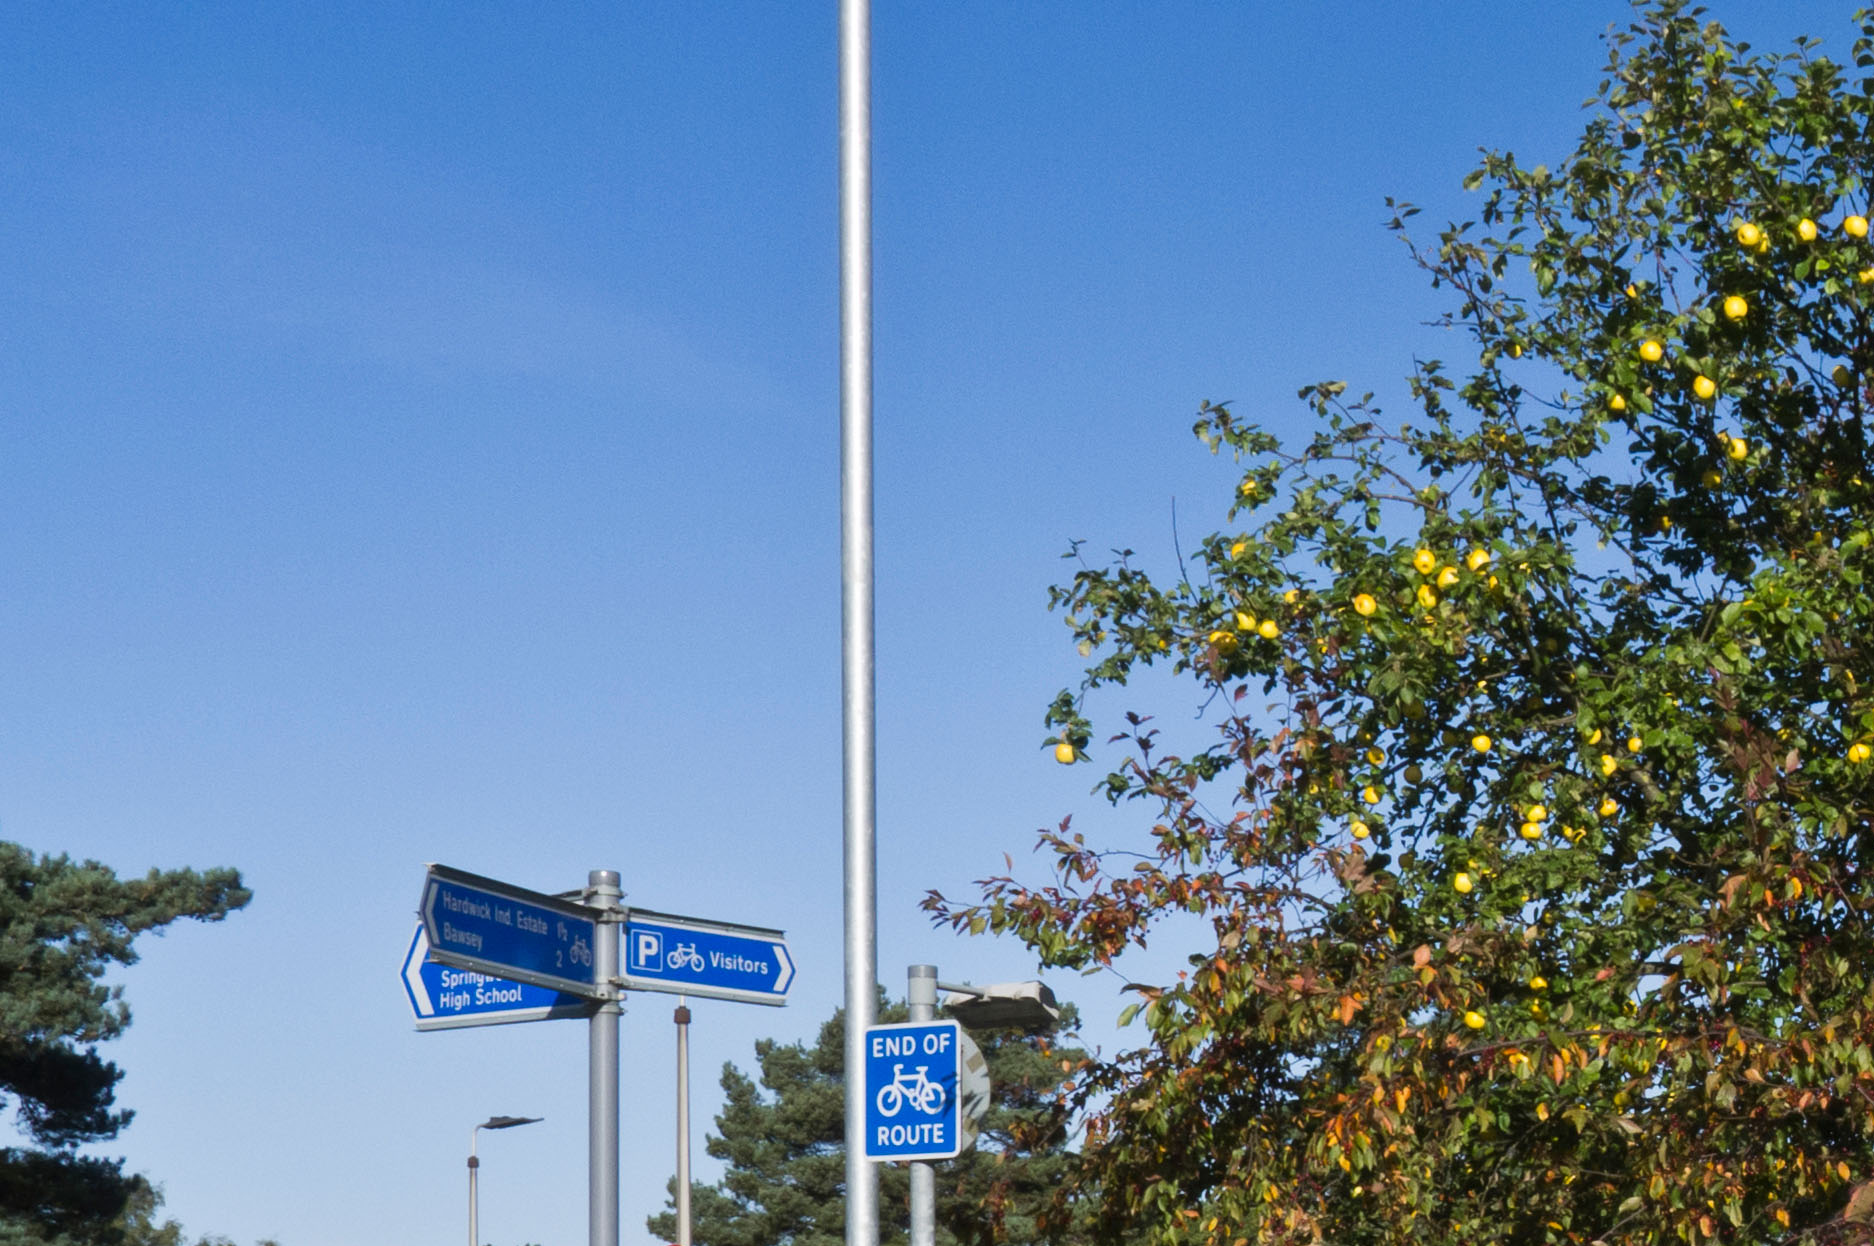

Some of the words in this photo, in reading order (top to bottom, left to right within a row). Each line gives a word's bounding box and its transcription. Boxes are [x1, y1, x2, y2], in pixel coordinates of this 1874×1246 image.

[442, 890, 492, 920] Hardwick
[494, 905, 513, 927] Ind.
[517, 910, 549, 935] Estate
[443, 923, 483, 952] Bawsey
[556, 950, 564, 968] 2
[638, 935, 659, 967] P
[709, 950, 769, 975] Visitors
[440, 988, 470, 1011] High
[475, 984, 522, 1006] School
[872, 1036, 916, 1058] END
[923, 1033, 951, 1055] OF
[877, 1123, 945, 1146] ROUTE
